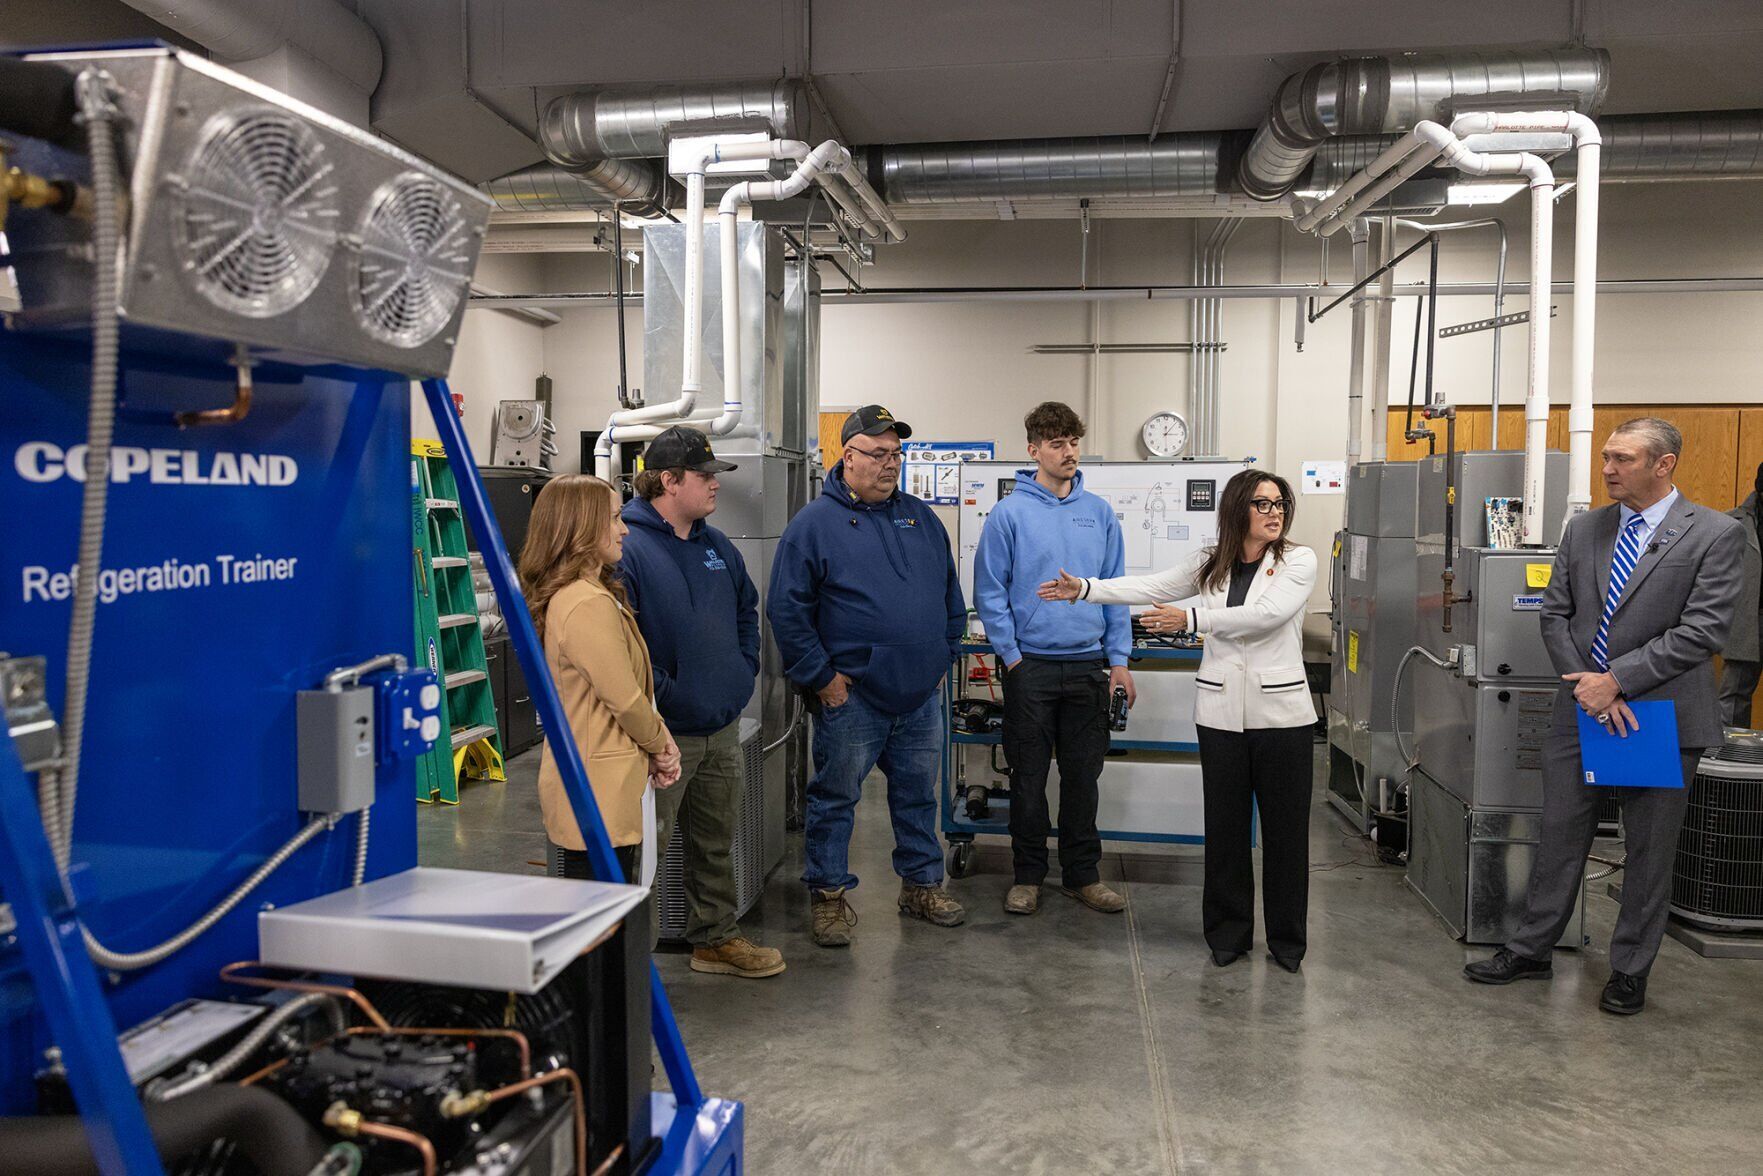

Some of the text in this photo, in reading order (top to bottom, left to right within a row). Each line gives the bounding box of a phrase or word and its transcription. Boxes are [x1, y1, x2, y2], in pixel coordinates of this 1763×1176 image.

[14, 441, 299, 487] COPELAND
[22, 553, 298, 604] Refgeration Trainer
